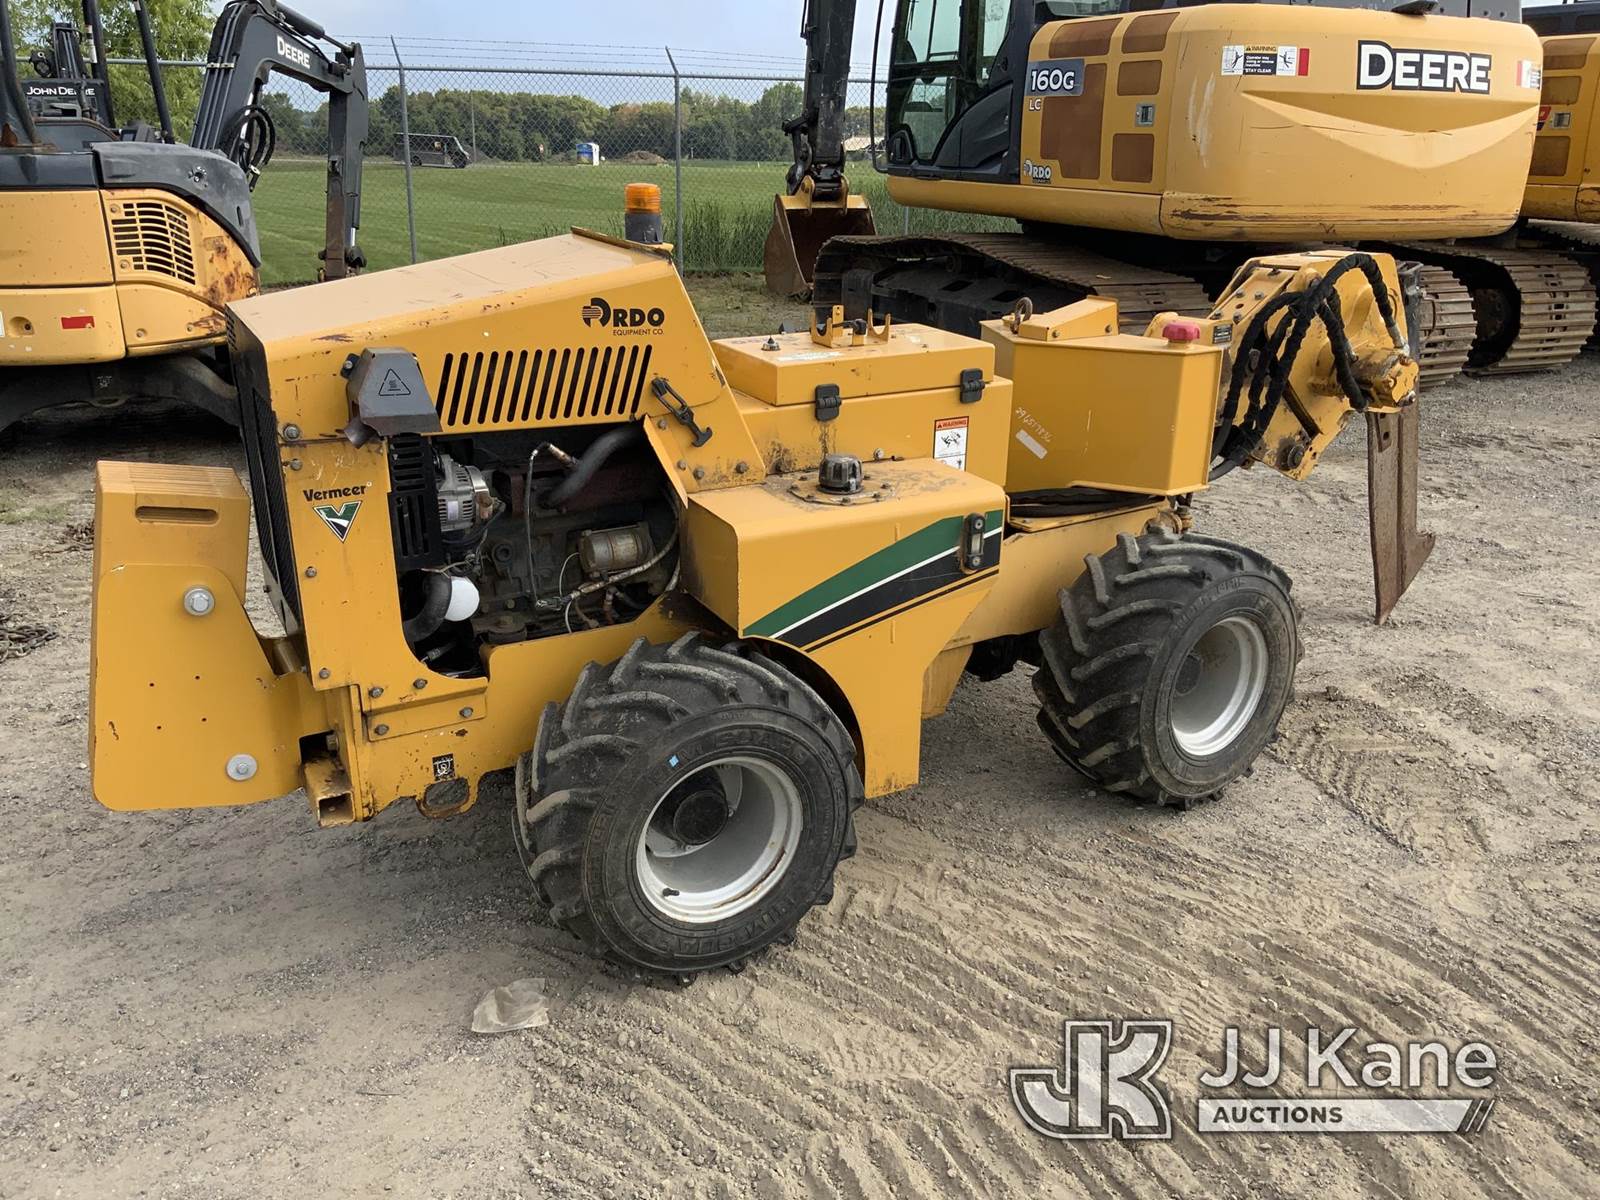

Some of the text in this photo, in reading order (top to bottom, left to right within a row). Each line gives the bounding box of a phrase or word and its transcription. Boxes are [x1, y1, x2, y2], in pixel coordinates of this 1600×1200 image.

[277, 35, 310, 69] DEERE
[1358, 41, 1491, 93] DEERE
[1031, 69, 1075, 91] 160G
[26, 86, 57, 95] JOHN
[1029, 98, 1042, 111] LC
[612, 307, 665, 327] RDO
[303, 485, 367, 501] Vermeer
